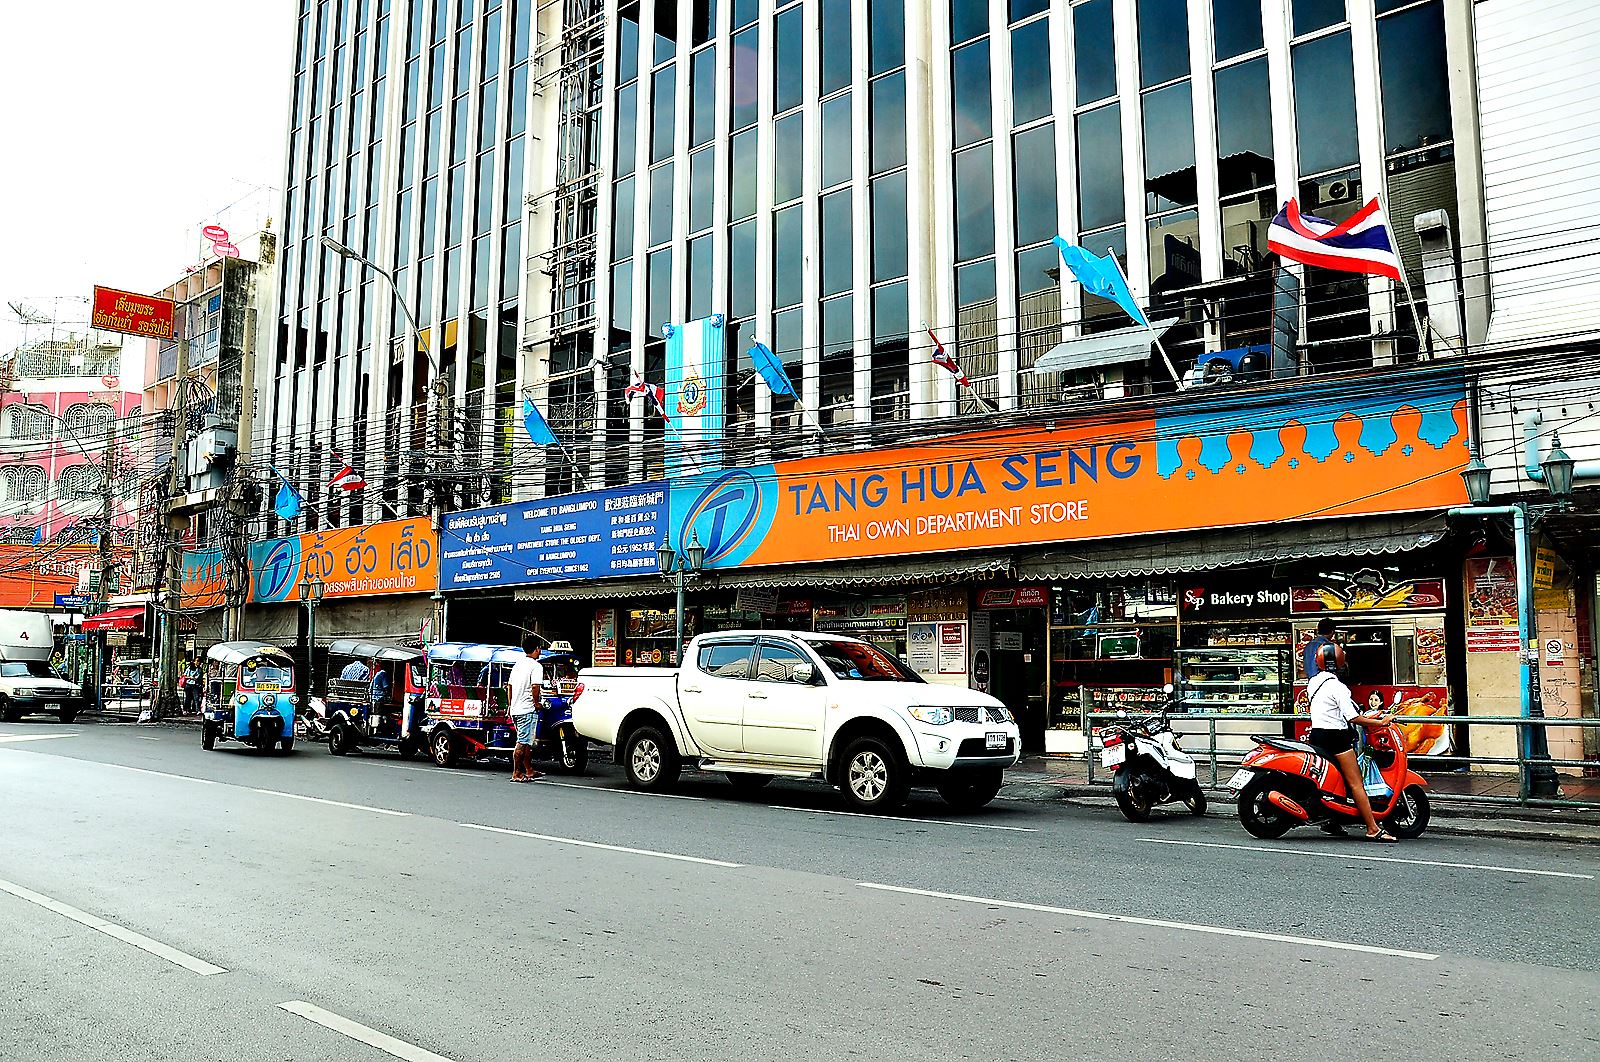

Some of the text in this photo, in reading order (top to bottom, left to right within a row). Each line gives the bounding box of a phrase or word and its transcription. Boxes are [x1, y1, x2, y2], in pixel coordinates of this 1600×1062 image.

[114, 294, 155, 316] เลี่ยมพระ
[788, 441, 1142, 516] TANG HUA SENG
[522, 508, 549, 520] WELCOME
[550, 506, 558, 516] TO
[827, 498, 1090, 543] THAI OWN DEPARTMENT STORE
[306, 534, 334, 579] ตั้ง
[390, 524, 431, 571] เส็ง
[516, 541, 544, 551] DEPARTMENT
[545, 539, 560, 547] STORE
[560, 537, 570, 546] THE
[570, 535, 588, 545] OLDEST
[526, 567, 539, 576] OPEN
[323, 571, 416, 594] งสรรพสินค้าของคนไทย
[1211, 591, 1254, 607] Bakery
[1257, 589, 1289, 606] Shop
[19, 631, 30, 641] 4
[556, 641, 570, 649] TAXI
